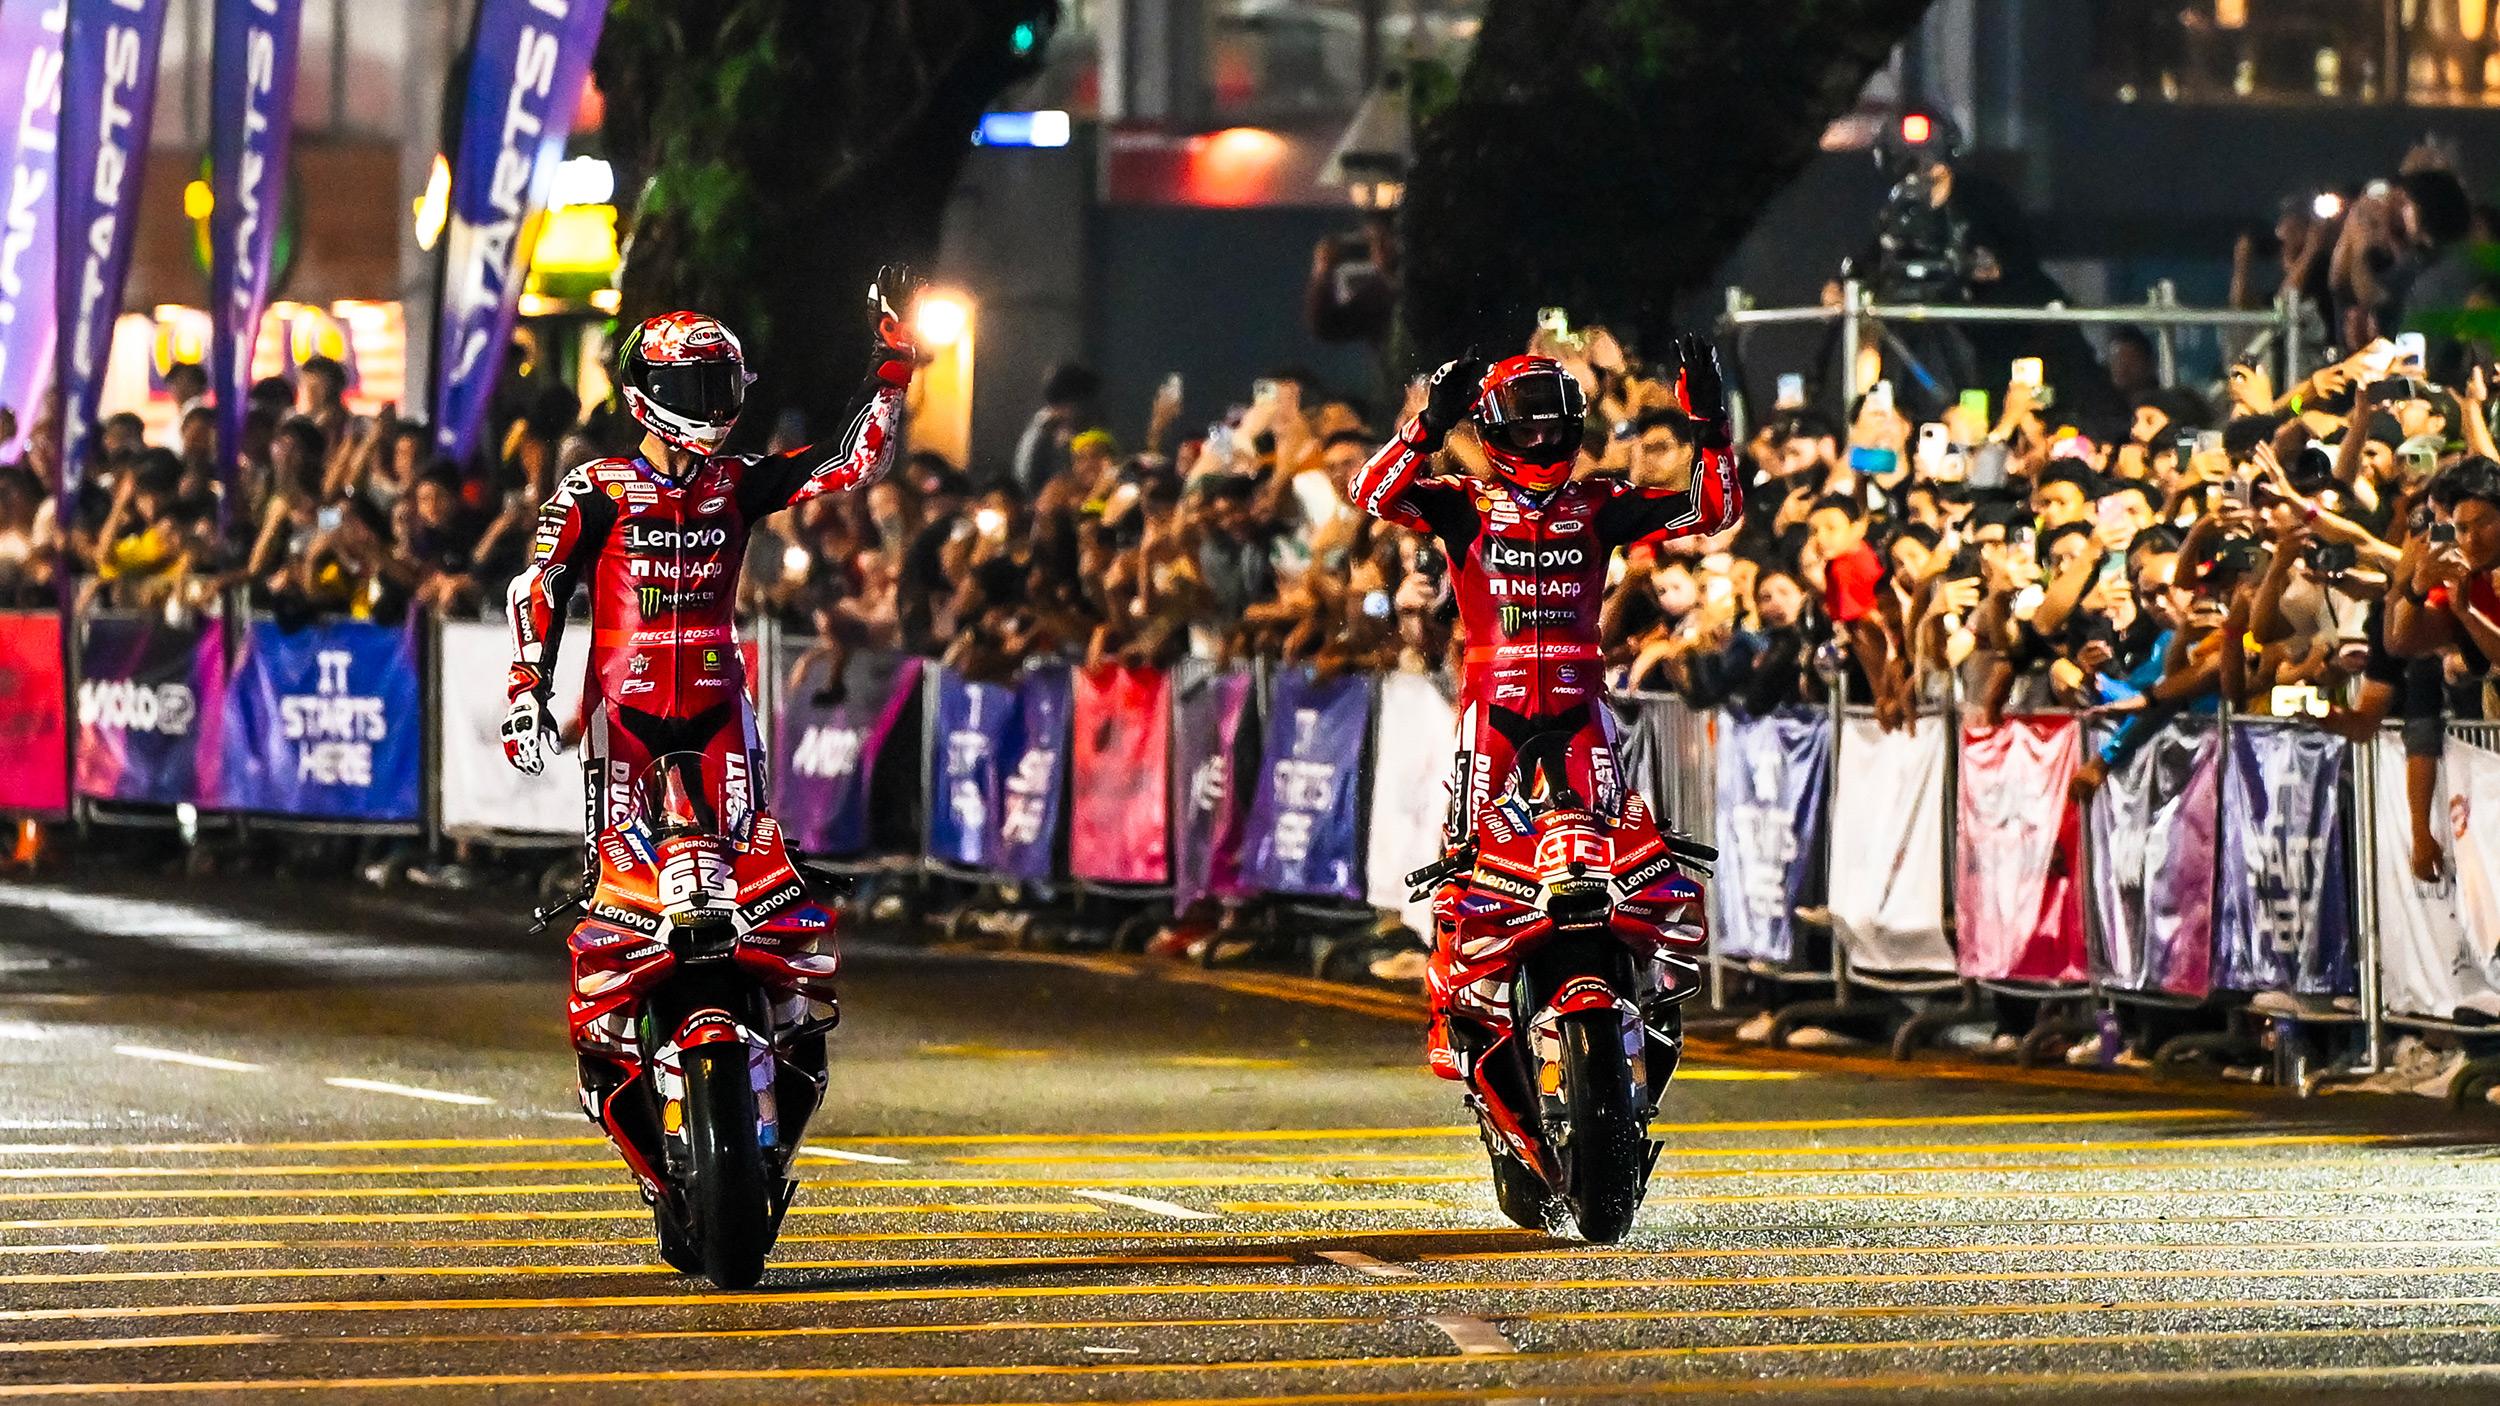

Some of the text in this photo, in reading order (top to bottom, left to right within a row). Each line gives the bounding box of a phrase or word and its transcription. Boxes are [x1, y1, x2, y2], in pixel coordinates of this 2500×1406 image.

[645, 411, 678, 434] Lenovo
[651, 472, 668, 485] TIM
[632, 525, 726, 548] Lenovo
[1491, 544, 1583, 567] Lenovo
[654, 560, 723, 579] NetApp
[662, 592, 714, 604] MONSTER
[1511, 579, 1581, 598] NetApp
[518, 601, 533, 643] Lenovo
[1522, 609, 1576, 620] MONSTER
[1493, 668, 1527, 678] VERTICAL
[281, 695, 385, 741] STARTS
[611, 760, 630, 824] DUC
[1544, 812, 1593, 826] VARGROUP
[1626, 794, 1645, 822] riello
[755, 817, 777, 847] riello
[1482, 814, 1513, 844] riello
[603, 840, 634, 873] riello
[666, 840, 719, 853] VARGROUP
[658, 852, 739, 906] 63
[1475, 869, 1536, 898] Lenovo
[1617, 858, 1671, 892] Lenovo
[742, 886, 801, 921] Lenovo
[1671, 889, 1696, 898] TIM
[594, 900, 657, 931] Lenovo
[1477, 902, 1501, 914] TIM
[1505, 910, 1546, 926] CARRERA
[799, 918, 826, 928] TIM
[593, 934, 620, 947] TIM
[625, 943, 667, 960] CARRERA
